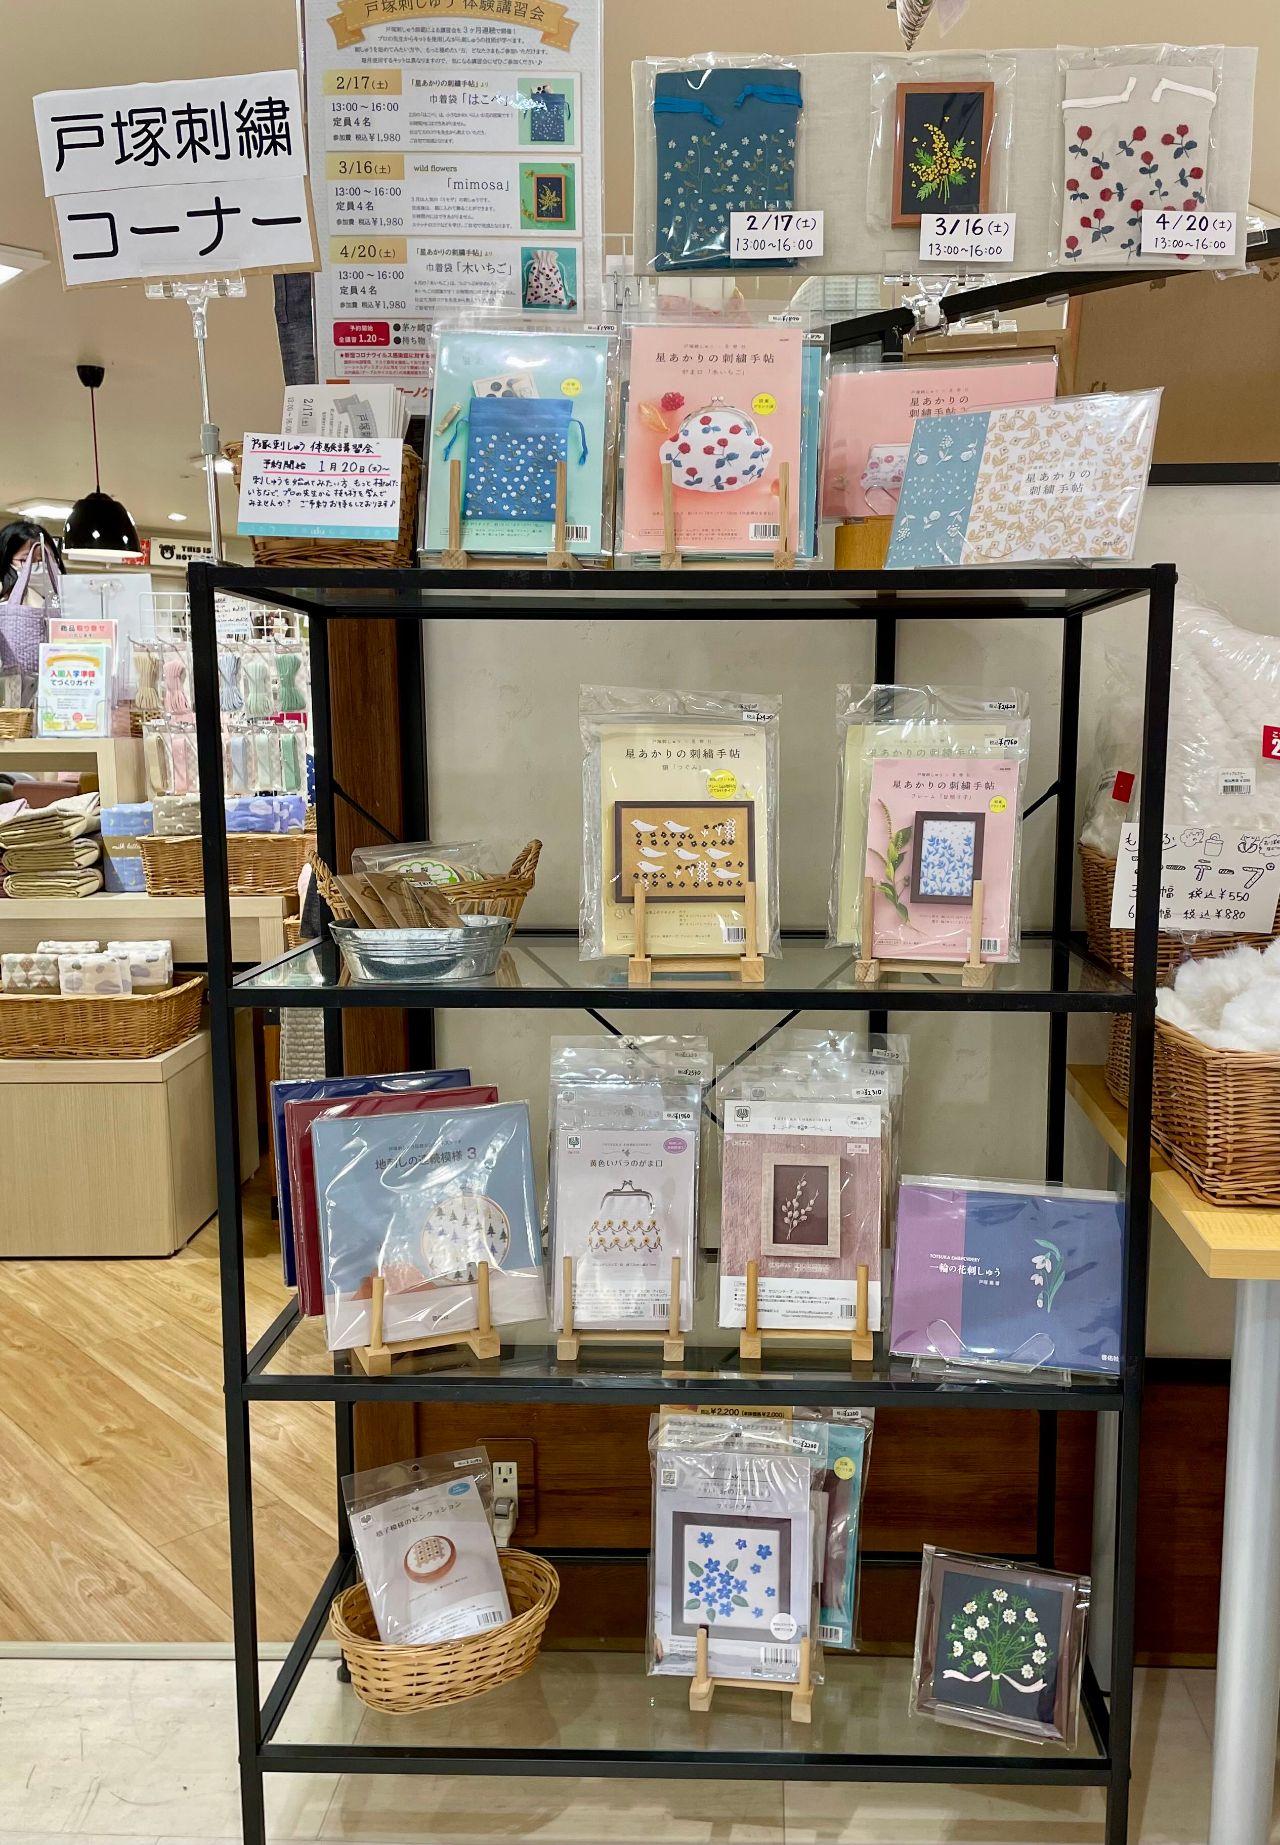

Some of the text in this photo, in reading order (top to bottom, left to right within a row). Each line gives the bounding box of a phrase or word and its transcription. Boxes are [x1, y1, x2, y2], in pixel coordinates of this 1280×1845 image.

[336, 76, 389, 90] 2/17(土)
[429, 94, 458, 105] 巾着袋
[331, 102, 358, 112] 13:00
[371, 102, 399, 112] 16:00
[51, 96, 292, 172] 戸塚刺繍
[339, 160, 458, 174] 3/16(土) wild flowers
[447, 177, 510, 192] 「mimosa」
[335, 186, 361, 197] 13:00
[374, 186, 402, 197] 16:00
[67, 196, 302, 260] コーナー
[745, 214, 817, 232] 2/17(土)
[935, 217, 1010, 236] 3/16(土)
[1155, 213, 1232, 232] 4/20(土)
[339, 245, 396, 258] 4/20(土)
[426, 263, 453, 273] 巾着袋
[338, 270, 364, 280] 13:00
[377, 270, 404, 280] 16:00
[656, 352, 775, 364] 星あかりの刺繍手帖
[910, 395, 969, 407] 星あかりの
[263, 459, 307, 470] 予約開始
[1025, 469, 1091, 483] 星あかりの
[1029, 483, 1084, 496] 刺繍手帖
[181, 545, 202, 553] THIS
[625, 748, 740, 759] 星あかりの刺繍手帖
[893, 780, 995, 790] 星あかりの刺繍手帖
[467, 1146, 477, 1160] 3
[590, 1159, 663, 1168] 黄色いバラのがま口
[929, 1262, 1001, 1278] 一輪の花刺しゅう
